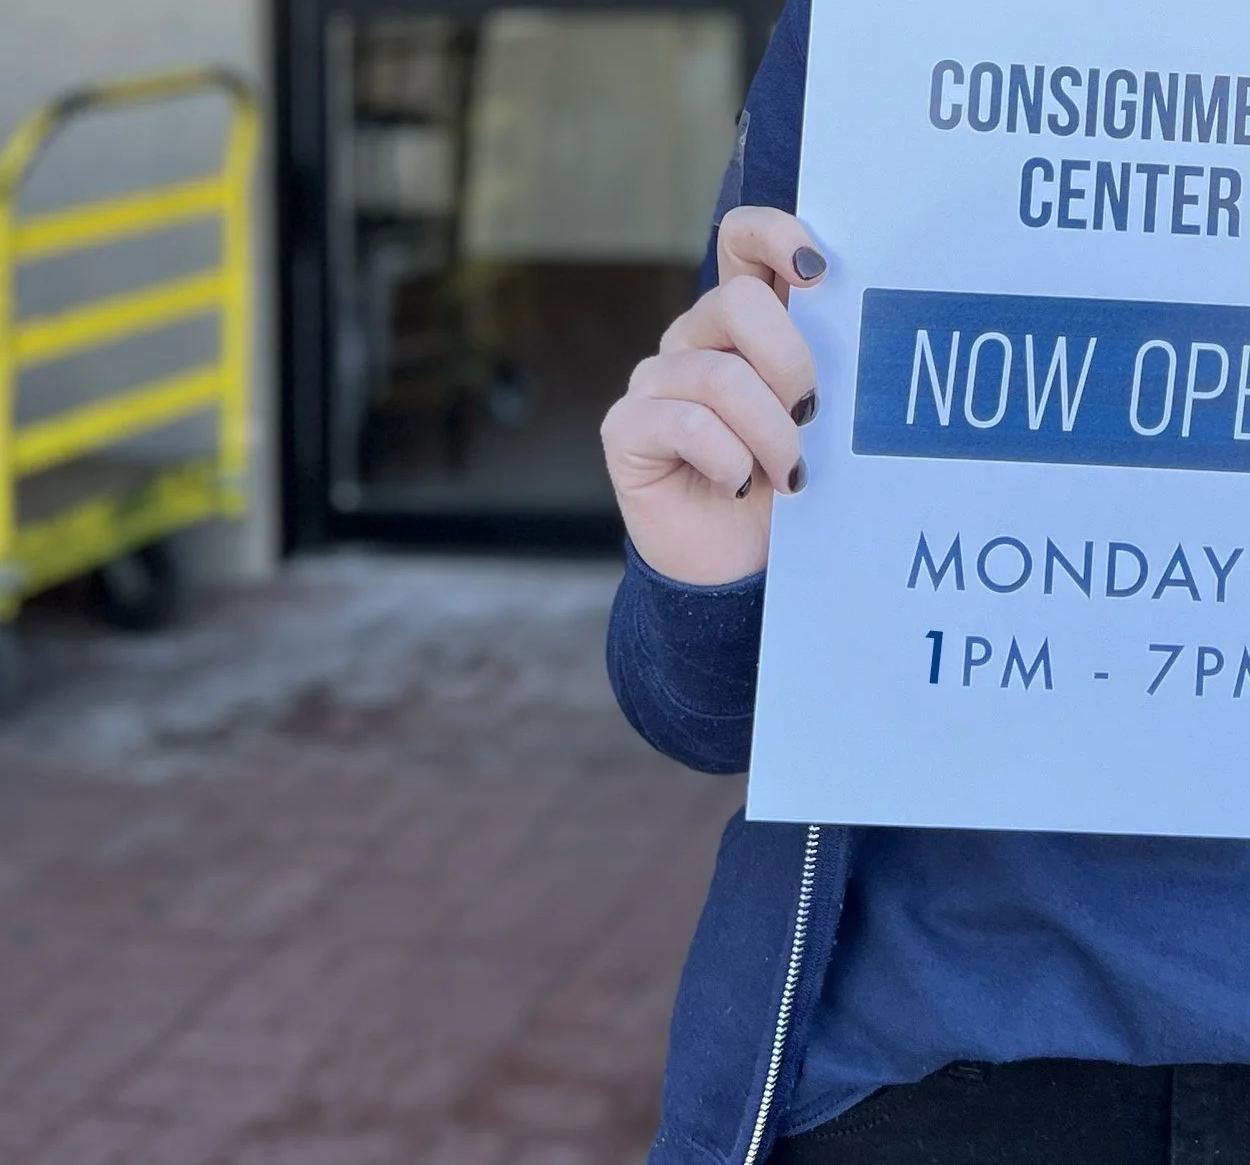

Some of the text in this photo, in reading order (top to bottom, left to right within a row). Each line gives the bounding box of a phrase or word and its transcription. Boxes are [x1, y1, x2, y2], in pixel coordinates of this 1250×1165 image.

[1019, 157, 1242, 238] CENTER
[905, 329, 1098, 432] NOW
[925, 629, 1054, 691] 1PM
